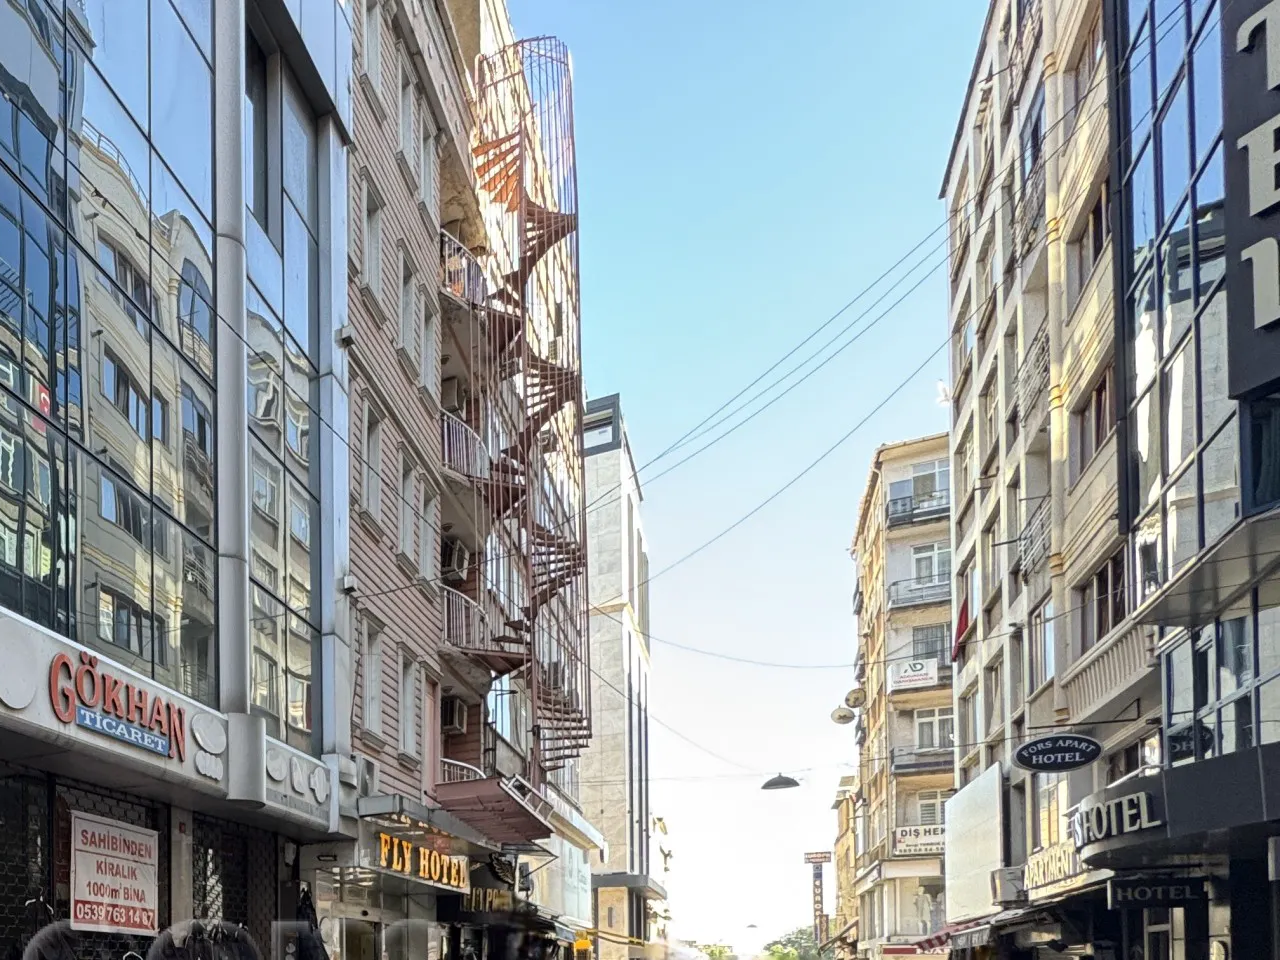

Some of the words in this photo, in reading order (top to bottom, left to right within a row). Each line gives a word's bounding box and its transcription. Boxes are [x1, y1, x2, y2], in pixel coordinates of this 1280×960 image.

[49, 651, 186, 762] GÖKHAN
[80, 708, 166, 752] TİCARET
[1021, 740, 1053, 757] FORS
[1056, 739, 1096, 752] APART
[1032, 752, 1085, 764] HOTEL
[1082, 791, 1162, 843] HOTEL
[900, 827, 920, 838] DİŞ
[81, 830, 152, 859] SAHİBİNDEN
[96, 858, 138, 880] KİRALIK
[380, 832, 412, 874] FLY
[419, 846, 467, 889] HOTEL
[1023, 847, 1074, 890] APARTMENT
[123, 884, 146, 903] BİNA
[1116, 885, 1200, 901] HOTEL
[76, 903, 105, 920] 0539
[107, 908, 126, 923] 763
[129, 909, 140, 924] 14
[142, 911, 154, 926] 87
